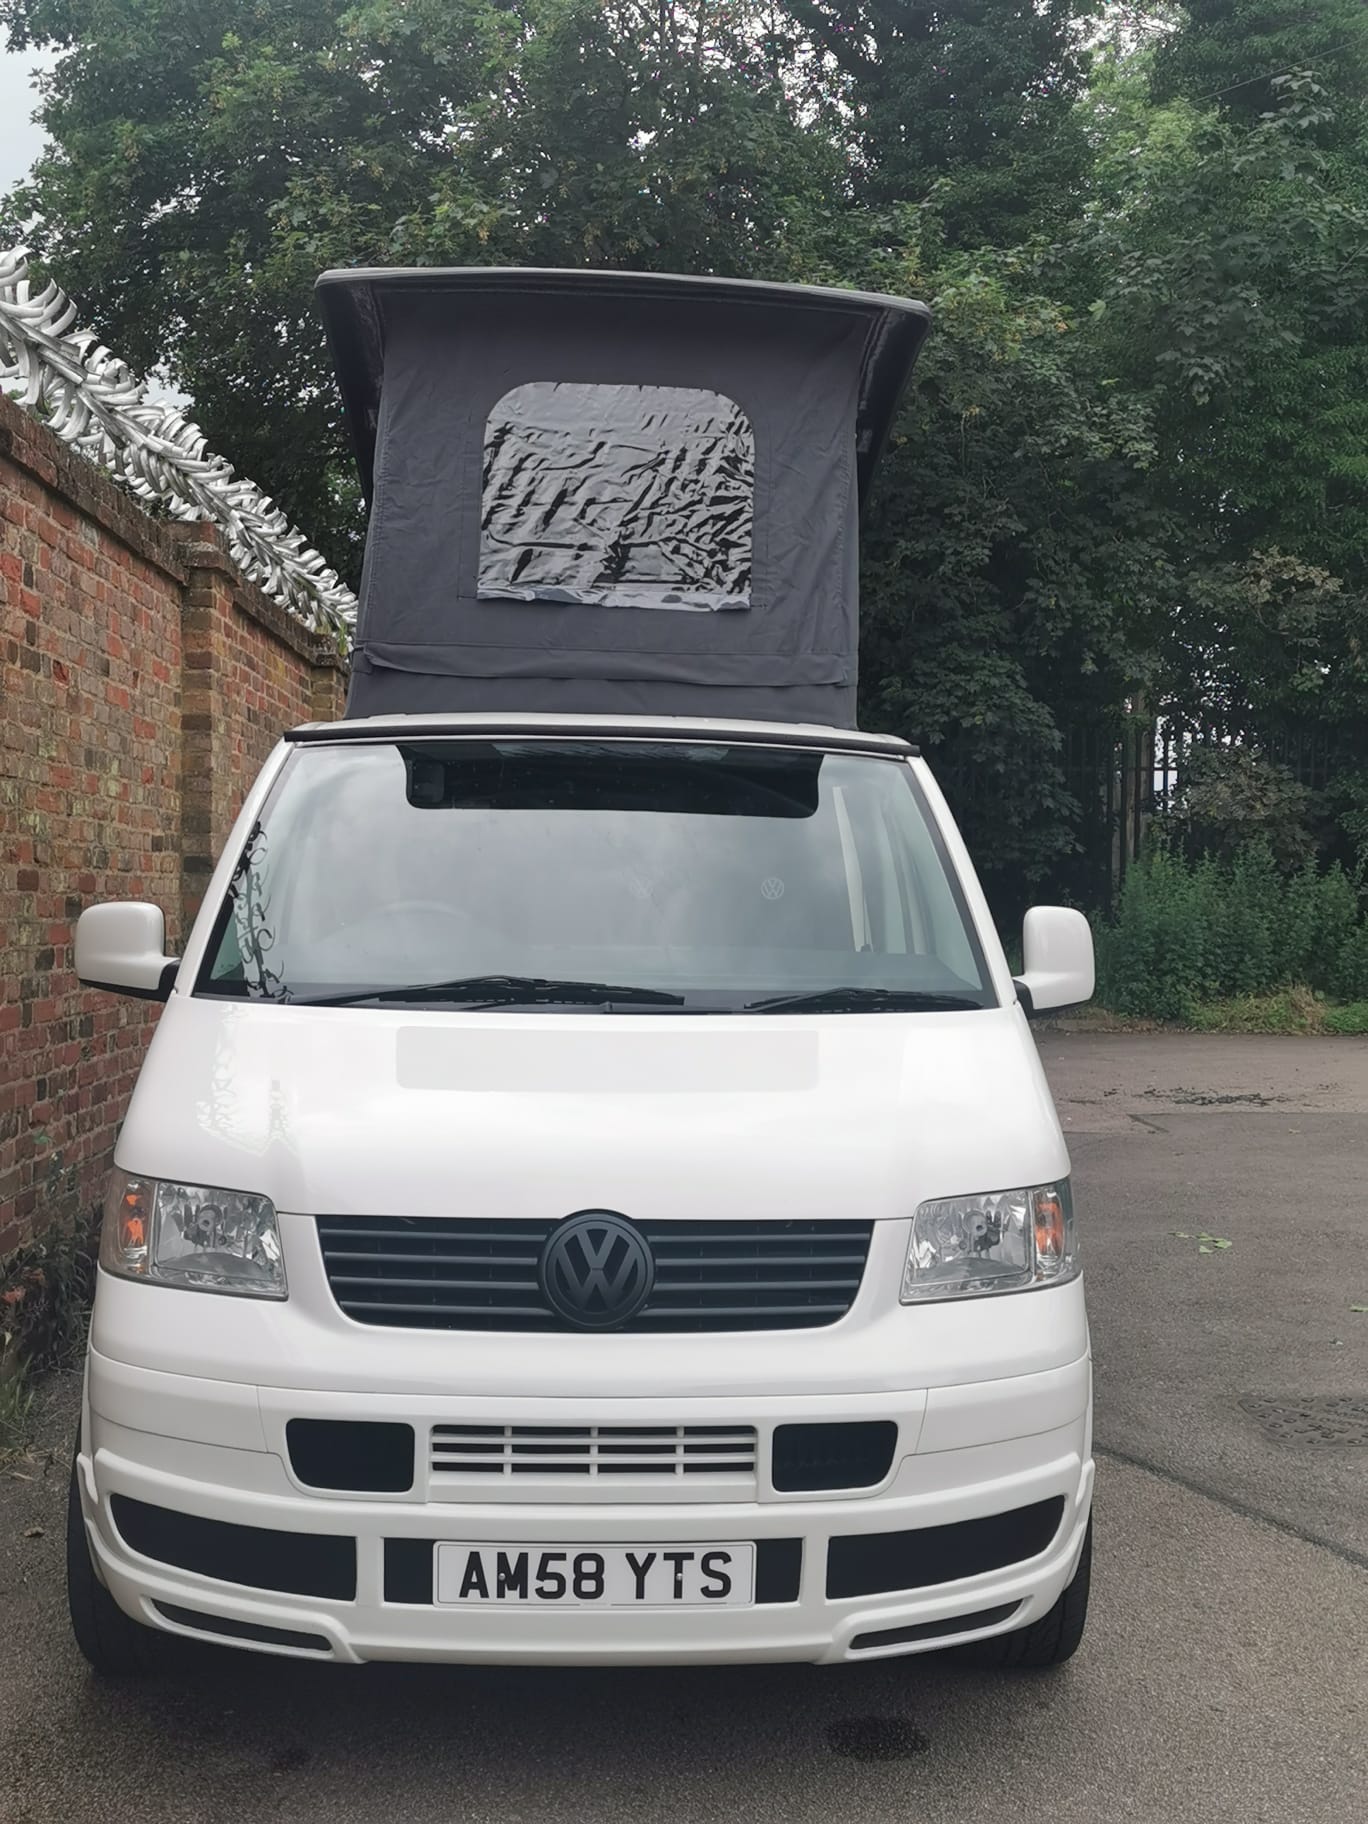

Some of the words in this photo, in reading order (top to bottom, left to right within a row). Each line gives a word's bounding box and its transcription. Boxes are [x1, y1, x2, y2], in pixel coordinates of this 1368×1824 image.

[548, 1219, 647, 1318] VW
[459, 1551, 605, 1600] AM58
[625, 1552, 732, 1599] YTS
